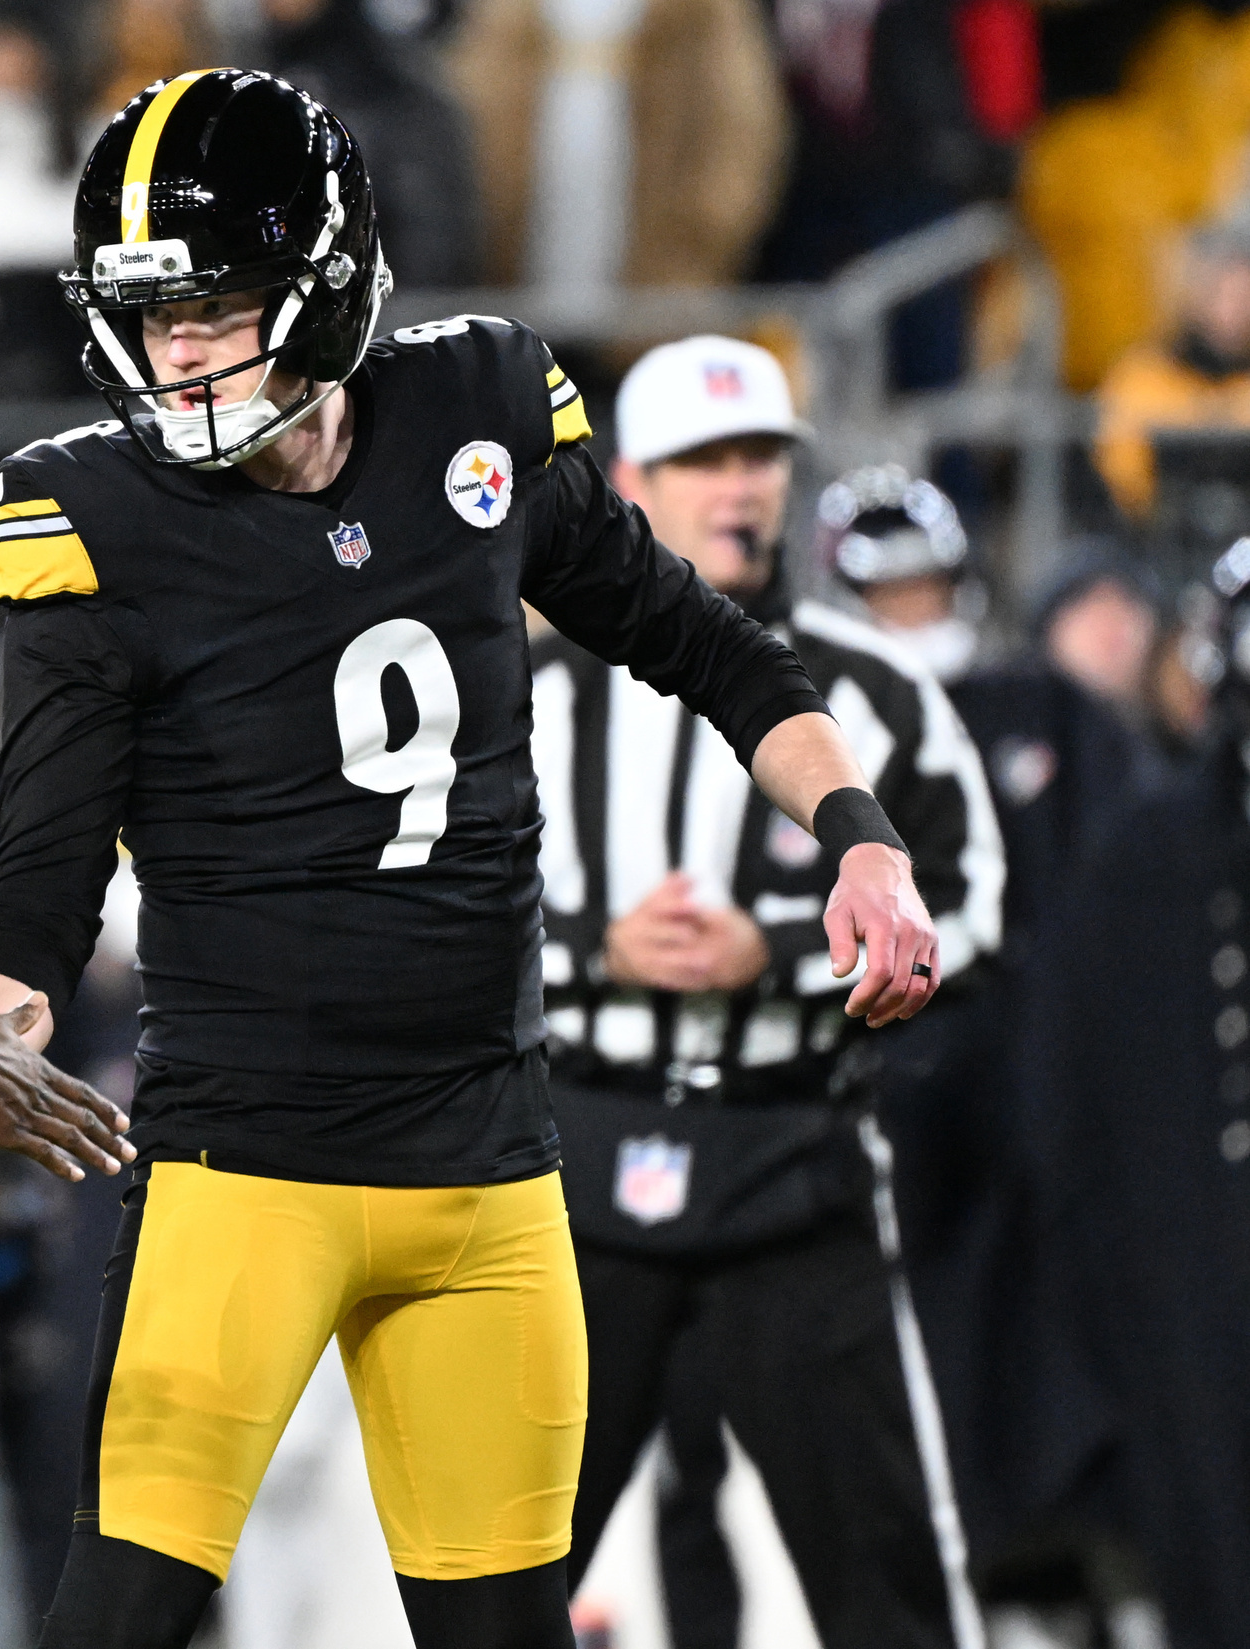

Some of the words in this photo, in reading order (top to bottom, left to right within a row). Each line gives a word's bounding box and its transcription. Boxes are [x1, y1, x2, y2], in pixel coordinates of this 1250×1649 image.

[121, 182, 147, 243] 9
[119, 251, 154, 265] Steelers
[452, 480, 482, 495] Steelers
[339, 540, 366, 561] NFL
[333, 618, 461, 870] 9
